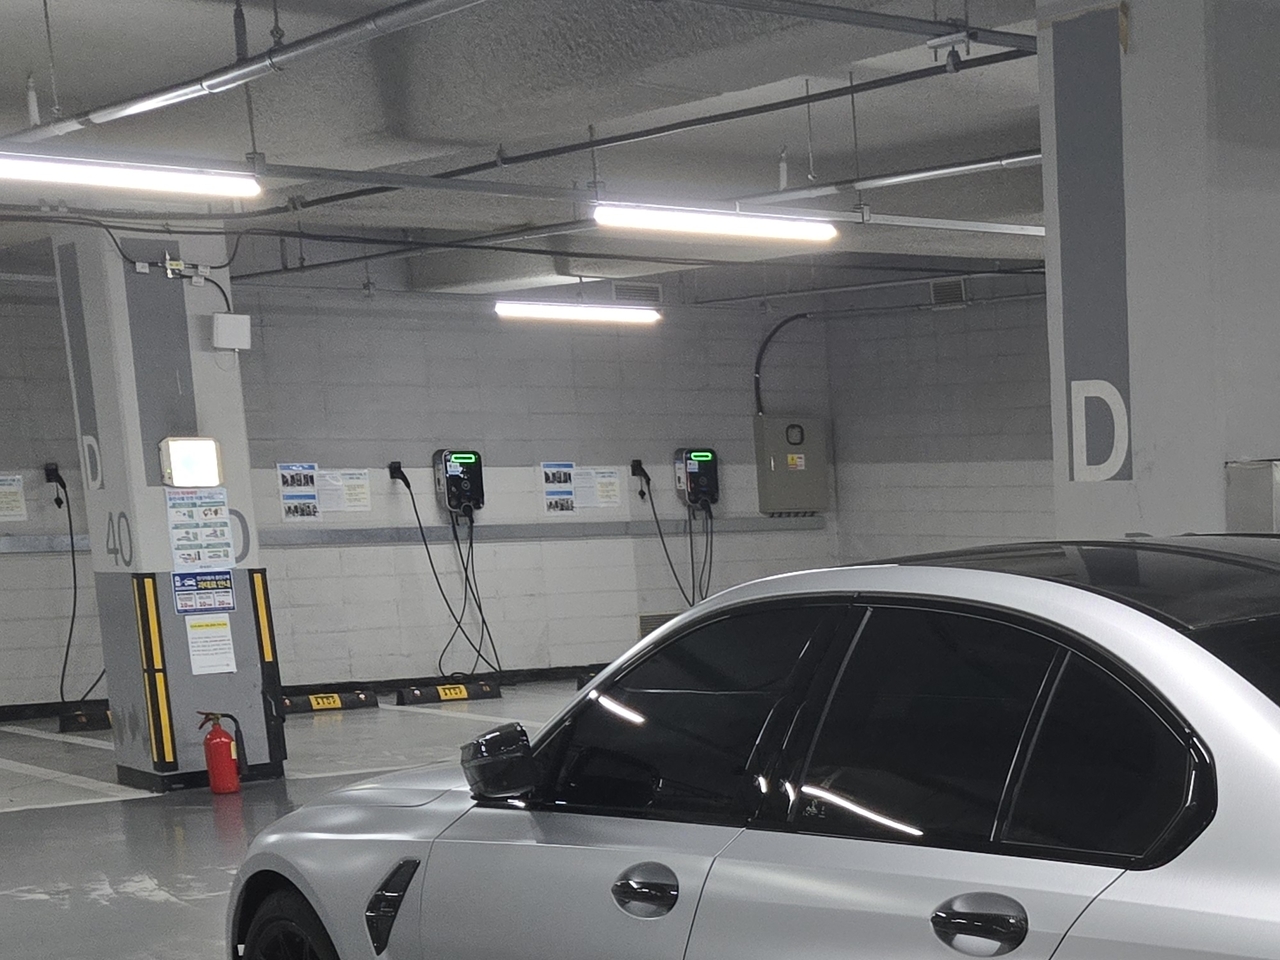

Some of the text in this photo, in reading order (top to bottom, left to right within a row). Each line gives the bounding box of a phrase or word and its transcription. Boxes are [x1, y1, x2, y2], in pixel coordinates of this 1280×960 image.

[1071, 379, 1129, 482] D
[82, 435, 102, 490] D
[106, 511, 133, 567] 40
